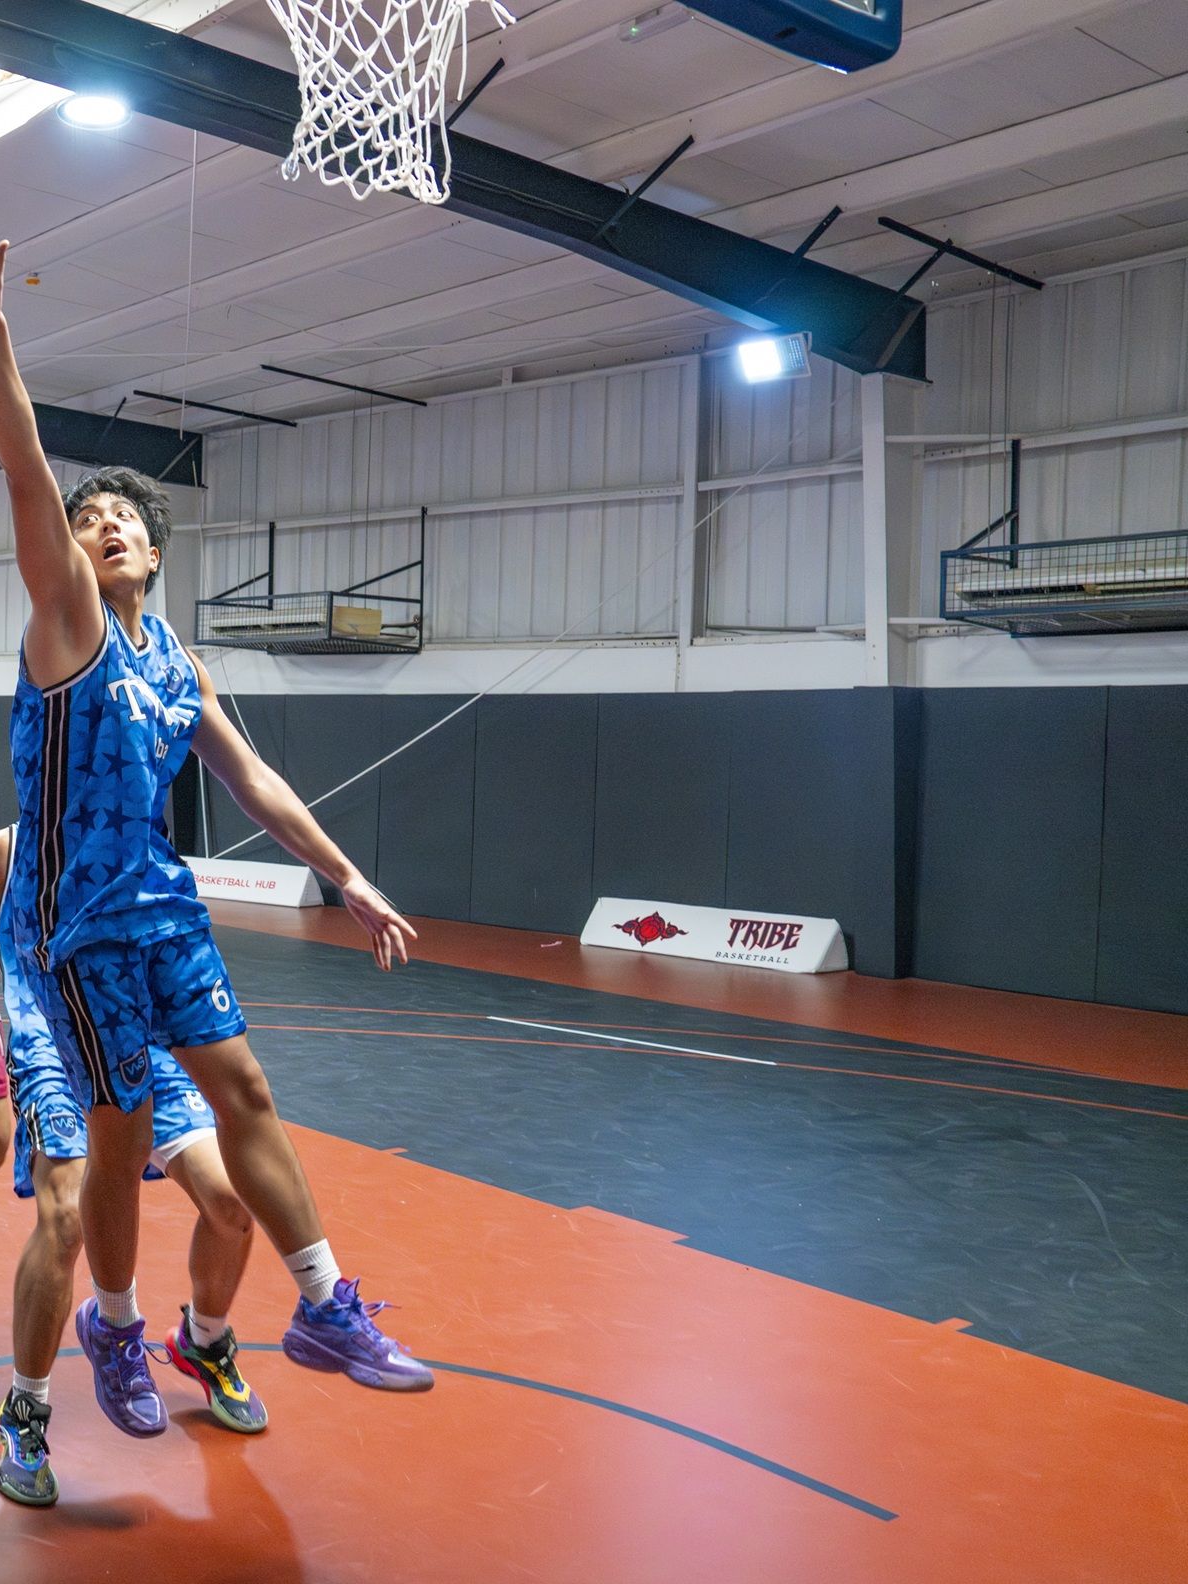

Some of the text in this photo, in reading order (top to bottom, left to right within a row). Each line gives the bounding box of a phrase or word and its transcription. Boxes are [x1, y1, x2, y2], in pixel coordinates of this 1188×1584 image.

[194, 873, 277, 890] BASKETBALL HUB
[727, 918, 804, 951] TRIBE
[715, 951, 789, 965] BASKETBALL
[211, 979, 230, 1013] 6
